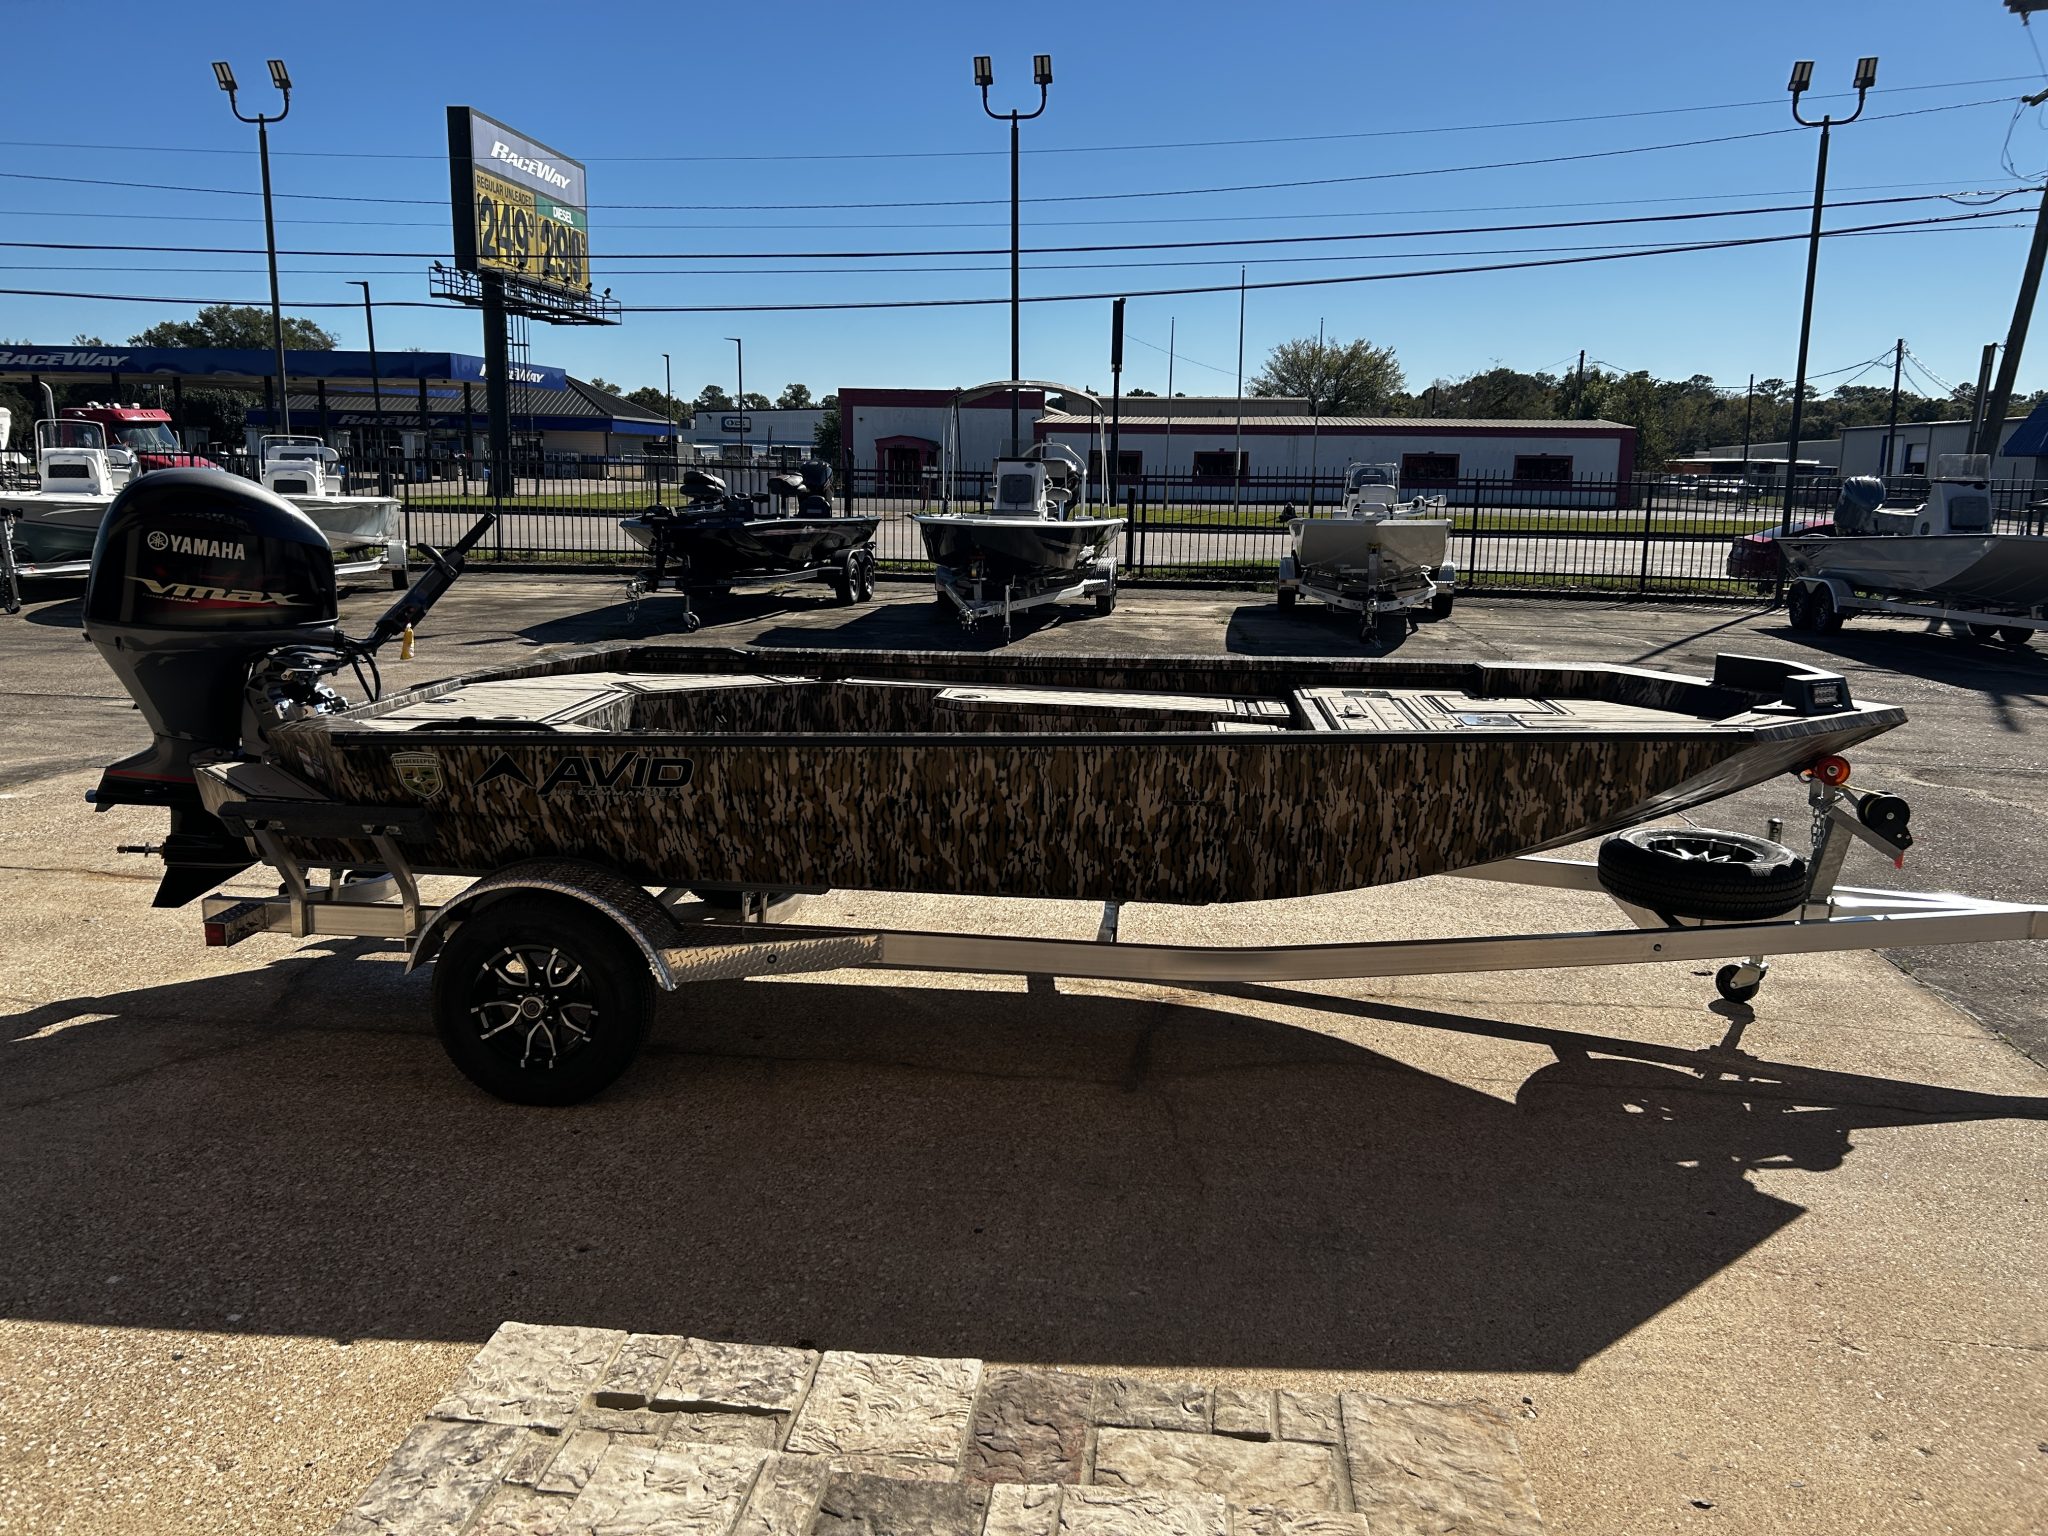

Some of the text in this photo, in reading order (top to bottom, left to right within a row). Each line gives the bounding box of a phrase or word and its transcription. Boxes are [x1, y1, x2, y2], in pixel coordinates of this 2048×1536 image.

[476, 175, 504, 196] REGULAR
[552, 206, 574, 225] DIESEL
[170, 533, 246, 561] YAMAHA
[537, 751, 695, 796] AVID
